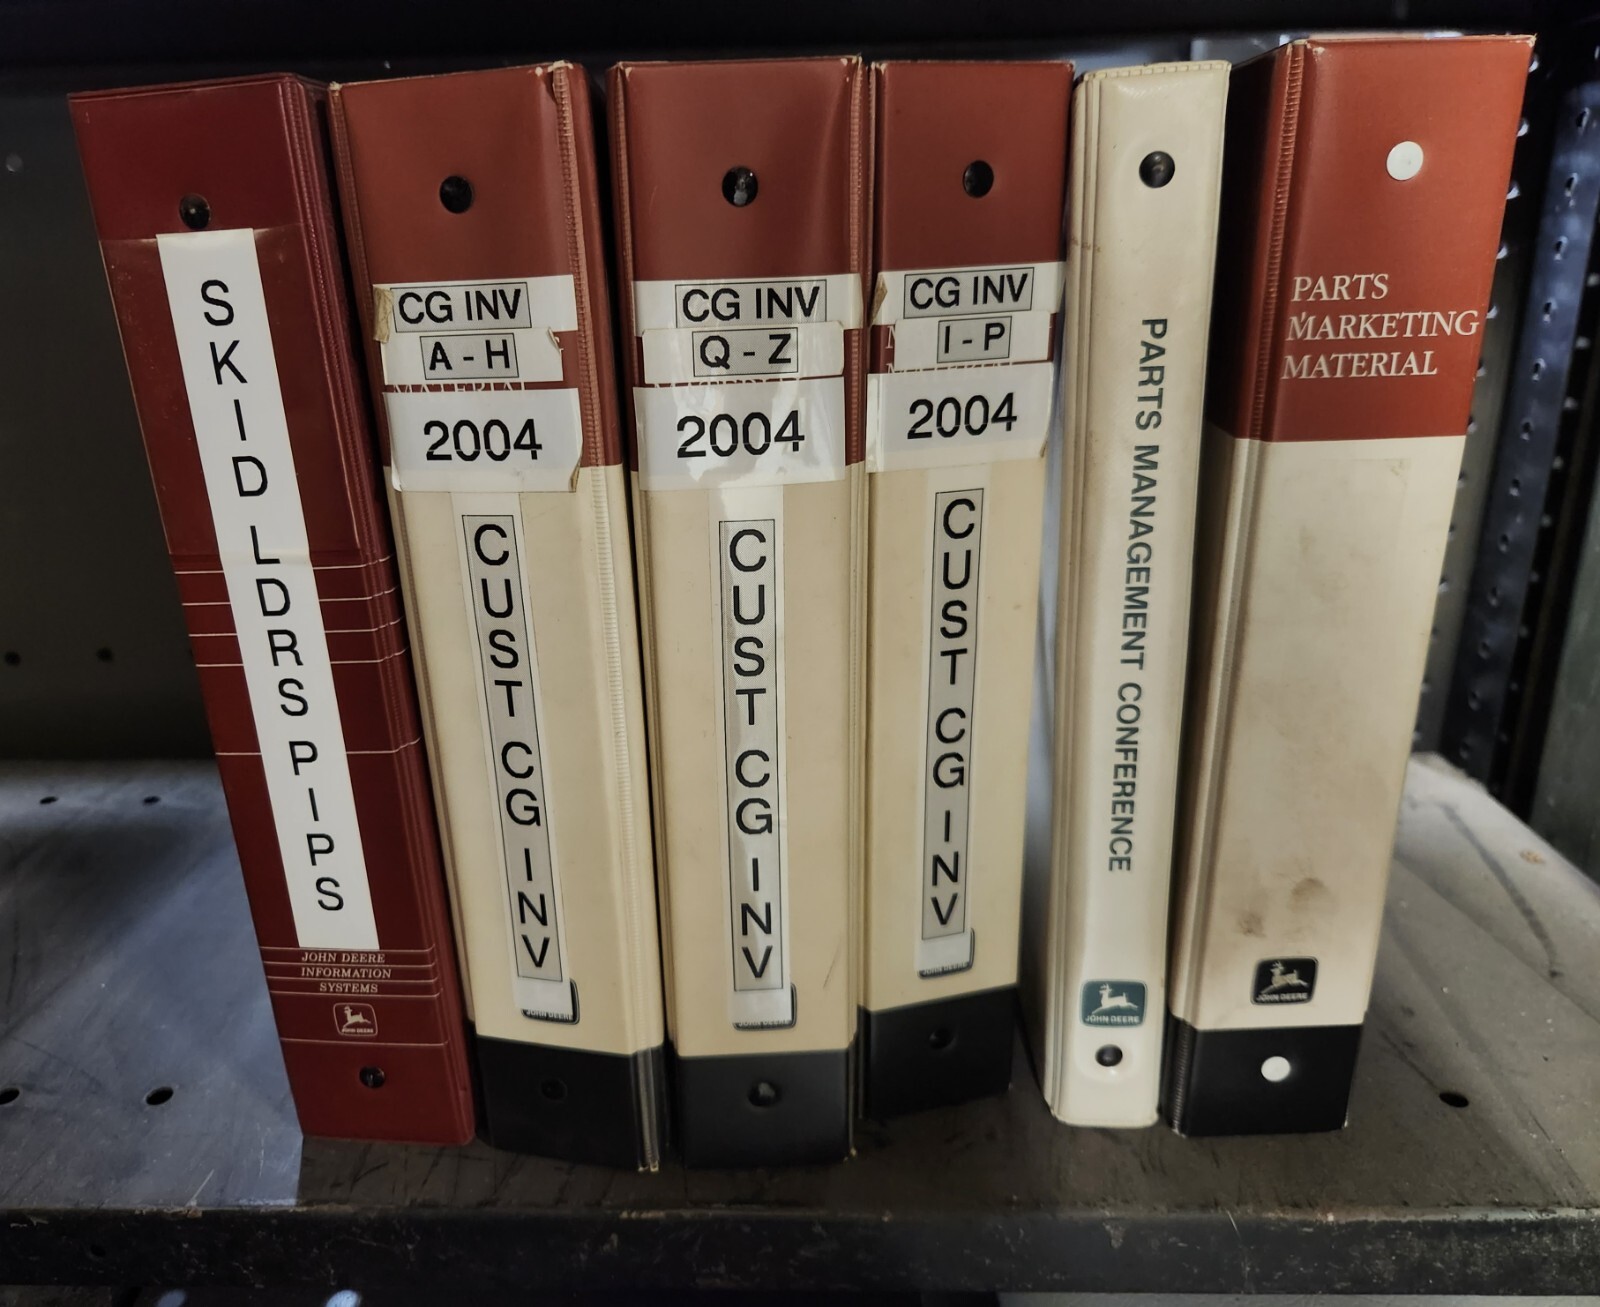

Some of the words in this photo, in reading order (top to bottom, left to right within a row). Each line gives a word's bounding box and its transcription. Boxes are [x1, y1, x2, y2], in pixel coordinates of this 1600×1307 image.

[398, 291, 453, 324] CG
[465, 288, 521, 321] INV
[682, 288, 740, 322] CG
[755, 286, 820, 319] INV
[909, 277, 960, 310] CG
[972, 273, 1028, 305] INV
[1291, 273, 1389, 301] PARTS
[983, 322, 1005, 351] P
[1286, 310, 1480, 341] MARKETING
[429, 341, 453, 370] A
[485, 339, 510, 369] H
[699, 335, 731, 370] Q
[768, 333, 792, 364] Z
[1135, 318, 1168, 431] PARTS
[1280, 351, 1438, 380] MATERIAL
[676, 410, 805, 458] 2004
[907, 392, 1018, 439] 2004
[423, 418, 543, 462] 2004
[1119, 444, 1160, 671] MANAGEMENT
[200, 279, 268, 497] SKID
[250, 525, 309, 717] LDRS
[288, 740, 344, 911] PIPS
[940, 498, 976, 685] CUST
[473, 523, 523, 717] CUST
[729, 528, 767, 726] CUST
[932, 707, 966, 788] CG
[501, 741, 541, 827] CG
[735, 749, 773, 834] CG
[1108, 682, 1142, 872] CONFERENCE
[931, 809, 959, 925] INV
[517, 847, 550, 968] INV
[741, 857, 773, 979] INV
[301, 952, 337, 962] JOHN
[341, 953, 386, 963] DEERE
[301, 967, 392, 978] INFORMATION
[319, 983, 379, 993] SYSTEMS
[1084, 1015, 1109, 1023] JOHN
[1110, 1015, 1140, 1024] DEERE
